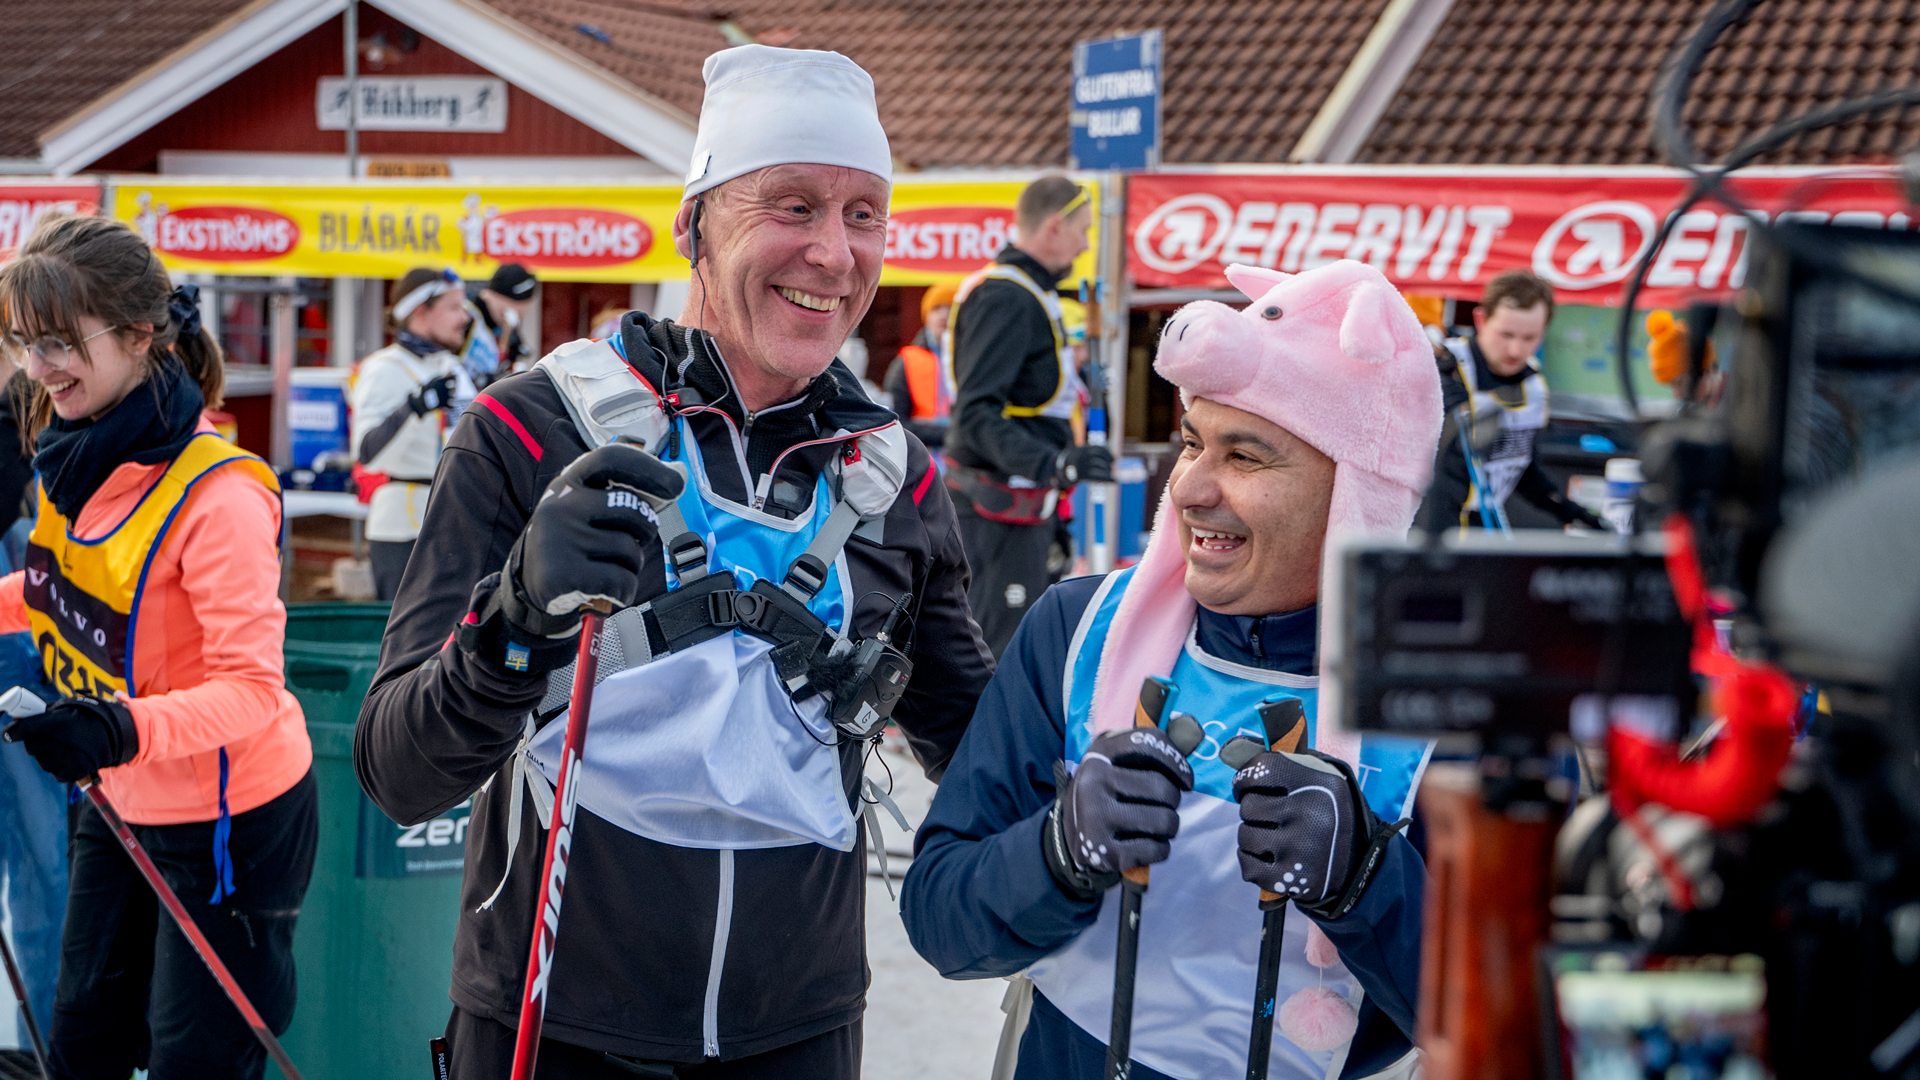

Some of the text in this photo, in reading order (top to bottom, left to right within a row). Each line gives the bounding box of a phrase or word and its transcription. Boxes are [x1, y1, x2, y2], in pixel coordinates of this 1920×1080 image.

[1087, 106, 1141, 138] BULLAR
[160, 214, 290, 252] EKSTRÖMS
[318, 203, 442, 252] BLÅBÄR
[487, 216, 642, 257] EKSTRÖMS
[884, 217, 1018, 260] EKSTRÖ
[1219, 203, 1512, 281] ENERVIT
[27, 566, 107, 647] VOLVO
[1130, 731, 1183, 764] CRAFT
